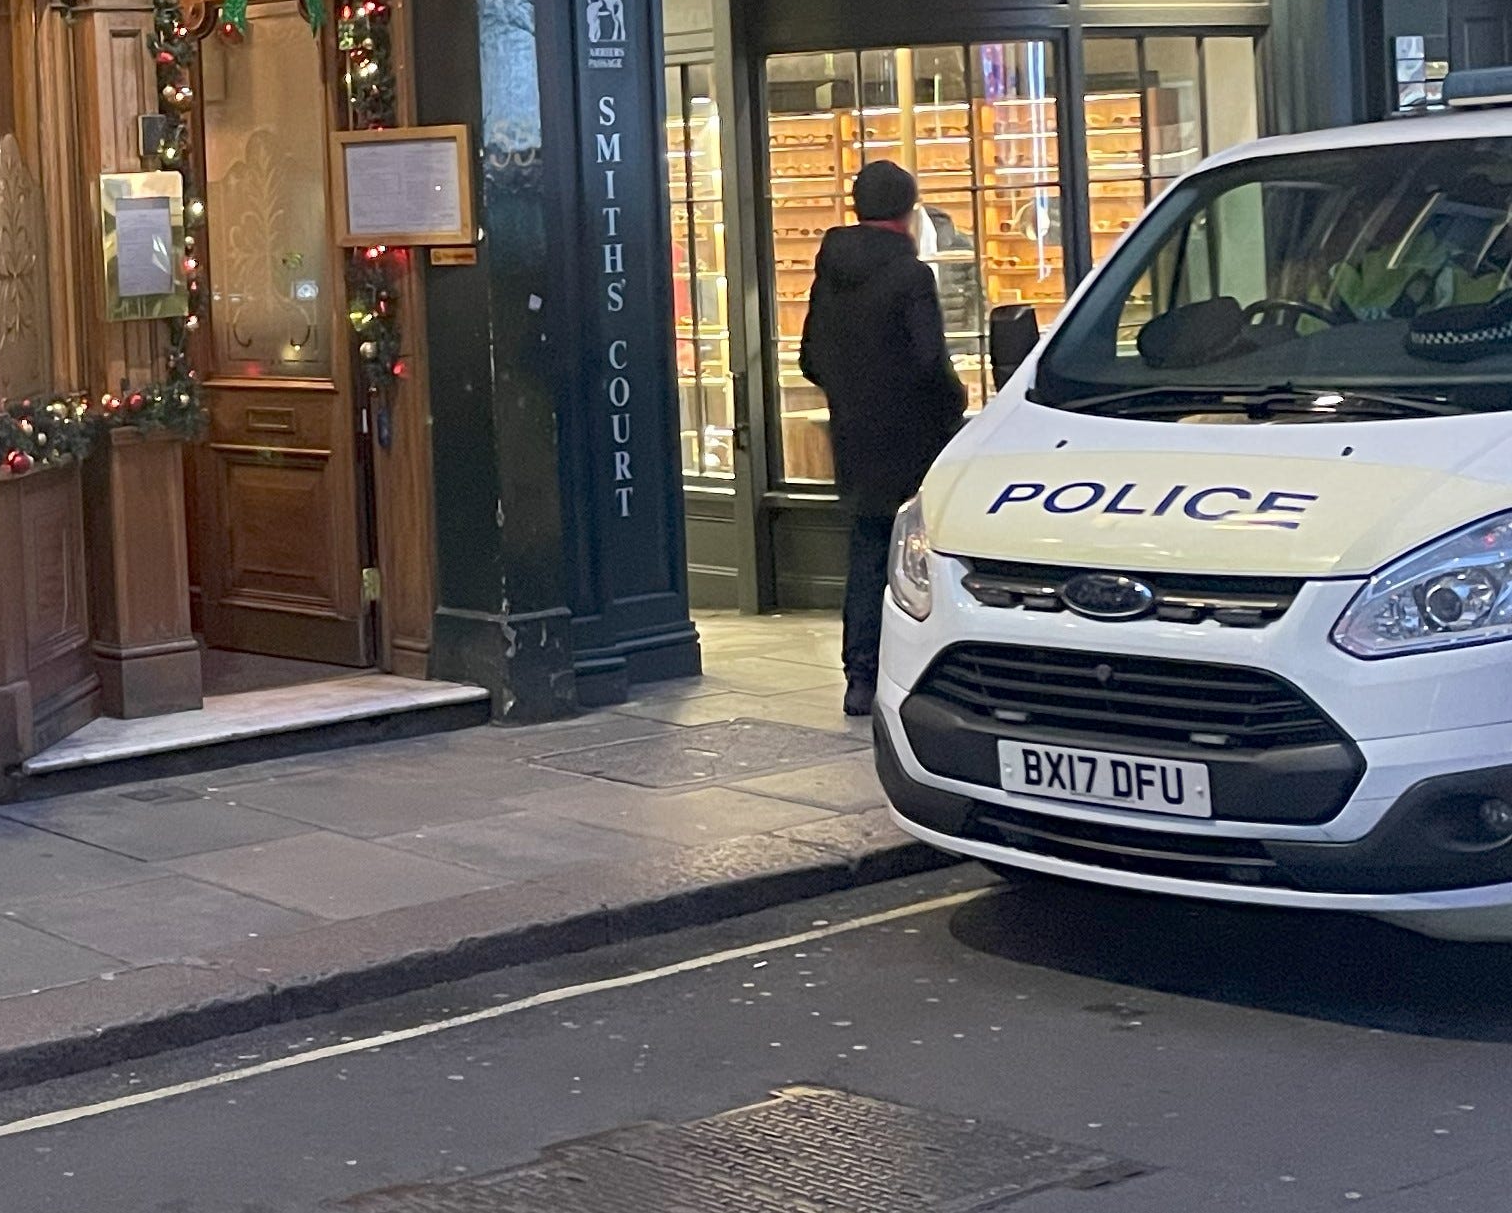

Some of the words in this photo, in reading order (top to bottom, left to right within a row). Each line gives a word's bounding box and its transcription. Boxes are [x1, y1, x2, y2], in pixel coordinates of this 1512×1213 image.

[608, 340, 634, 517] COURT
[985, 481, 1320, 530] POLICE
[1022, 748, 1098, 794] BX17
[1110, 759, 1185, 806] DFU
